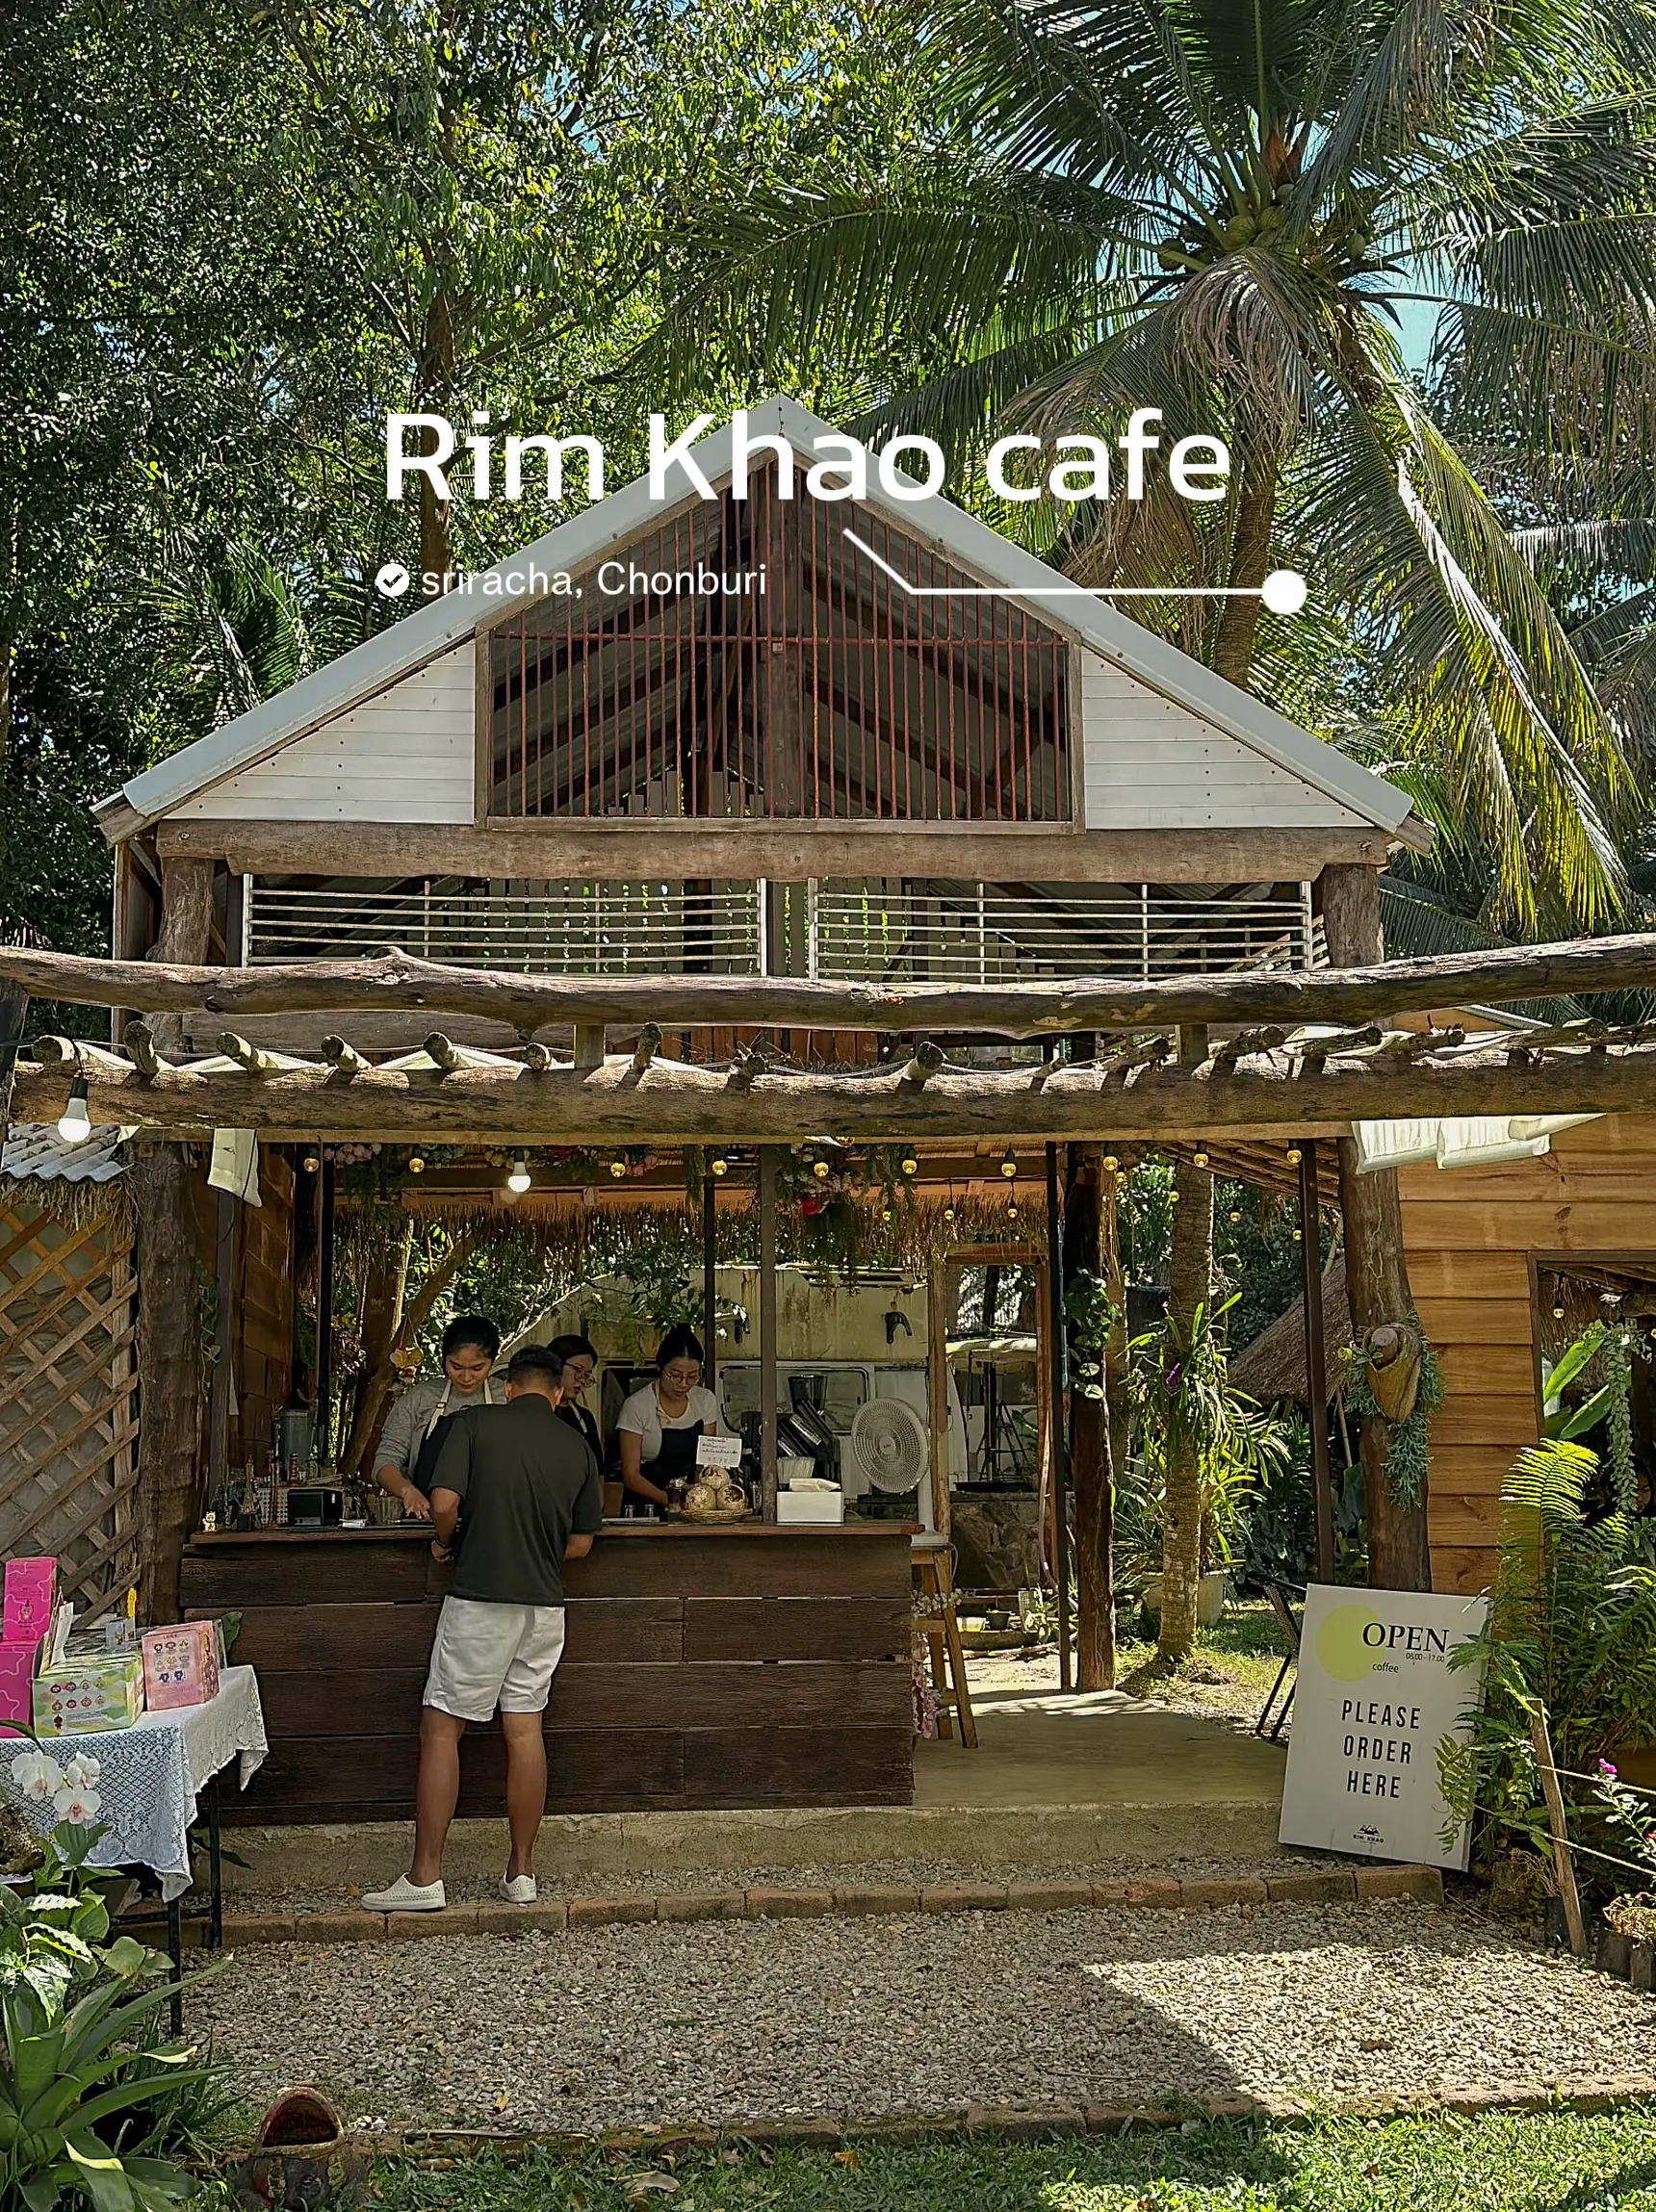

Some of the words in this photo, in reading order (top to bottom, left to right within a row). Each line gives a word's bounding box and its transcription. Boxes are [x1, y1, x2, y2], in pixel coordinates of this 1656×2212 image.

[1362, 1622, 1450, 1653] OPEN
[1372, 1662, 1399, 1673] coffee
[1341, 1699, 1421, 1729] PLEASE
[1343, 1735, 1411, 1764] ORDER
[1347, 1770, 1401, 1799] HERE
